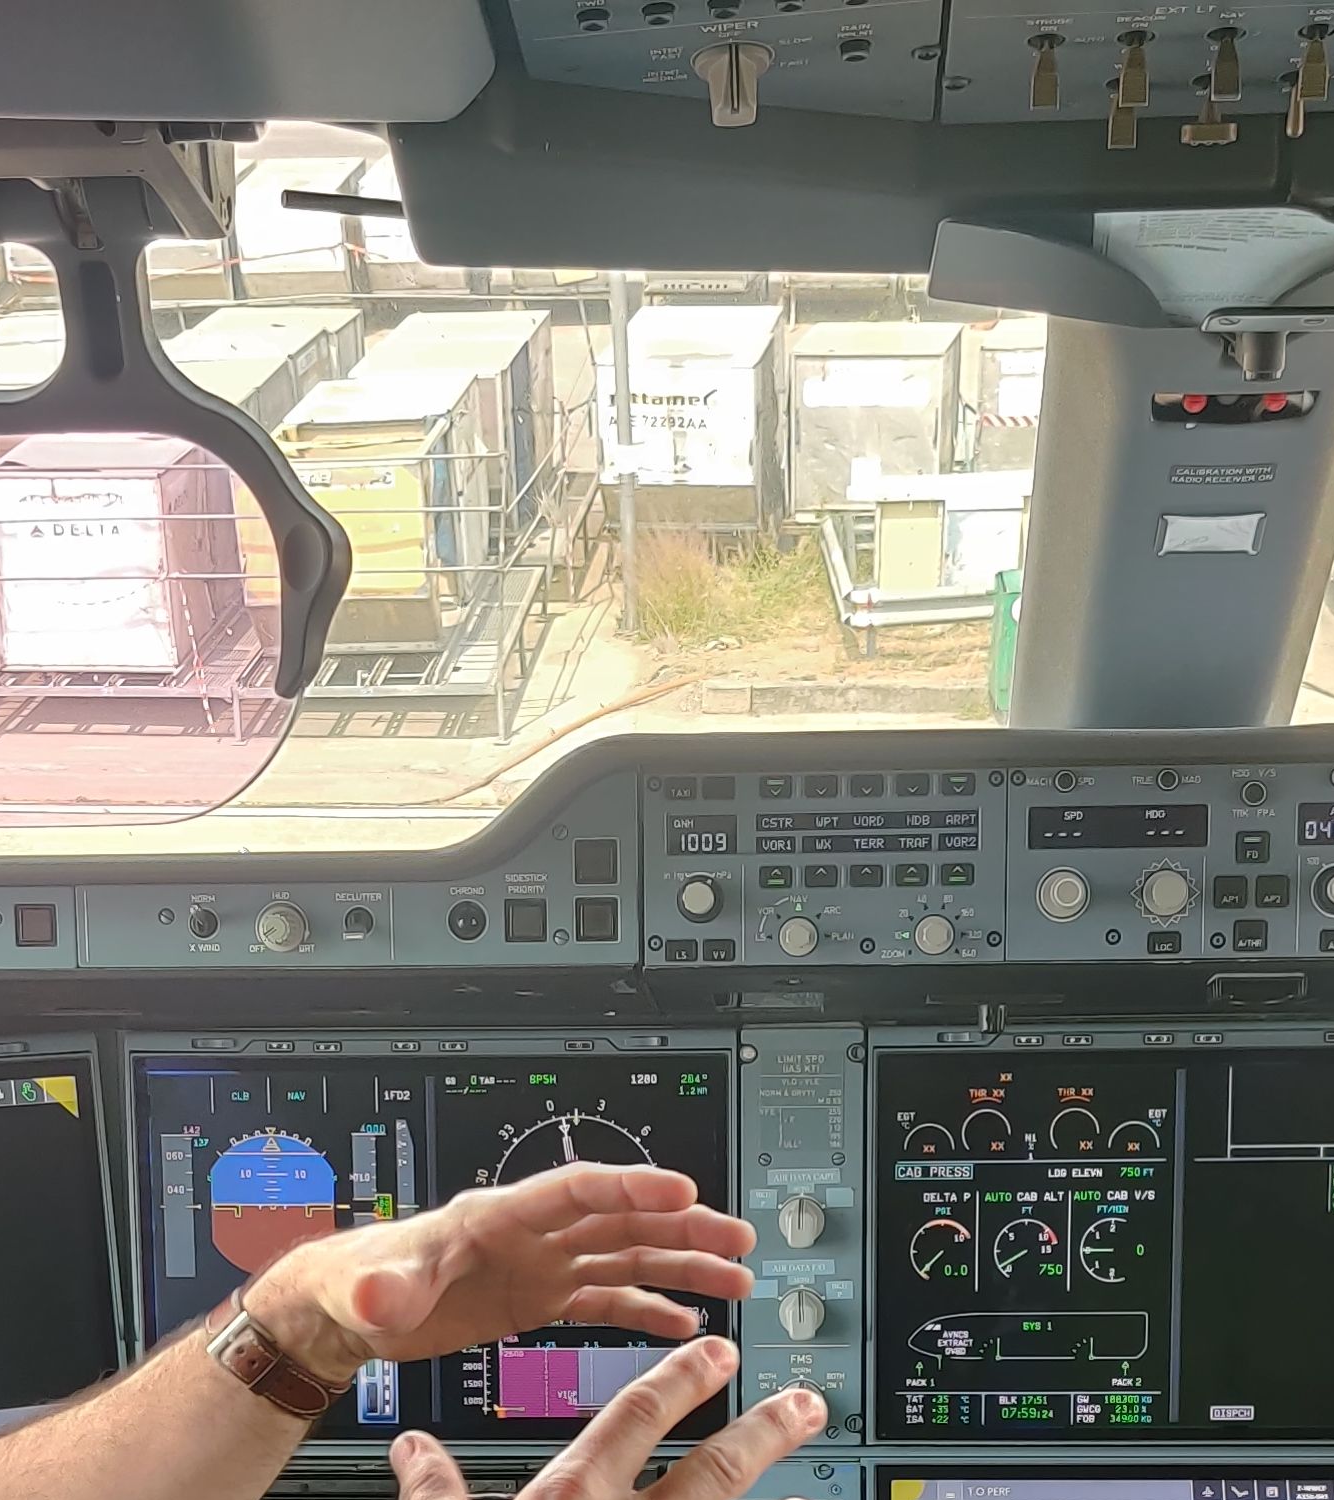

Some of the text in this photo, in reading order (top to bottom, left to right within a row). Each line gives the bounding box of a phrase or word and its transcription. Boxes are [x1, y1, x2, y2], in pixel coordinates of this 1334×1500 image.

[1190, 6, 1215, 14] LT
[699, 22, 759, 34] WIPER
[1205, 475, 1255, 483] RECEIVER
[53, 523, 121, 537] DELTA
[1064, 810, 1084, 821] SPD
[680, 834, 727, 851] 1009
[762, 836, 977, 850] VOR1 WX TERR TRAF VOR2
[1155, 943, 1173, 952] LOC
[881, 950, 906, 958] ZOOM
[231, 1091, 250, 1100] CLB
[287, 1091, 306, 1100] NAV
[384, 1090, 410, 1100] 1FD2
[898, 1167, 970, 1178] CAB PRESS
[1048, 1167, 1154, 1178] LDG ELEVN 750 FT
[167, 1185, 185, 1195] 040
[923, 1193, 971, 1202] DELTA P
[984, 1192, 1065, 1201] AUTO CAB ALT
[1073, 1191, 1155, 1200] AUTO CAB V/S
[944, 1264, 968, 1276] 0.0
[1039, 1264, 1063, 1275] 750
[937, 1338, 973, 1347] EXTRACT
[790, 1354, 813, 1364] FMS
[1001, 1407, 1054, 1419] 07:59:24
[1214, 1408, 1250, 1418] DISPCH
[988, 1488, 1011, 1496] PERF
